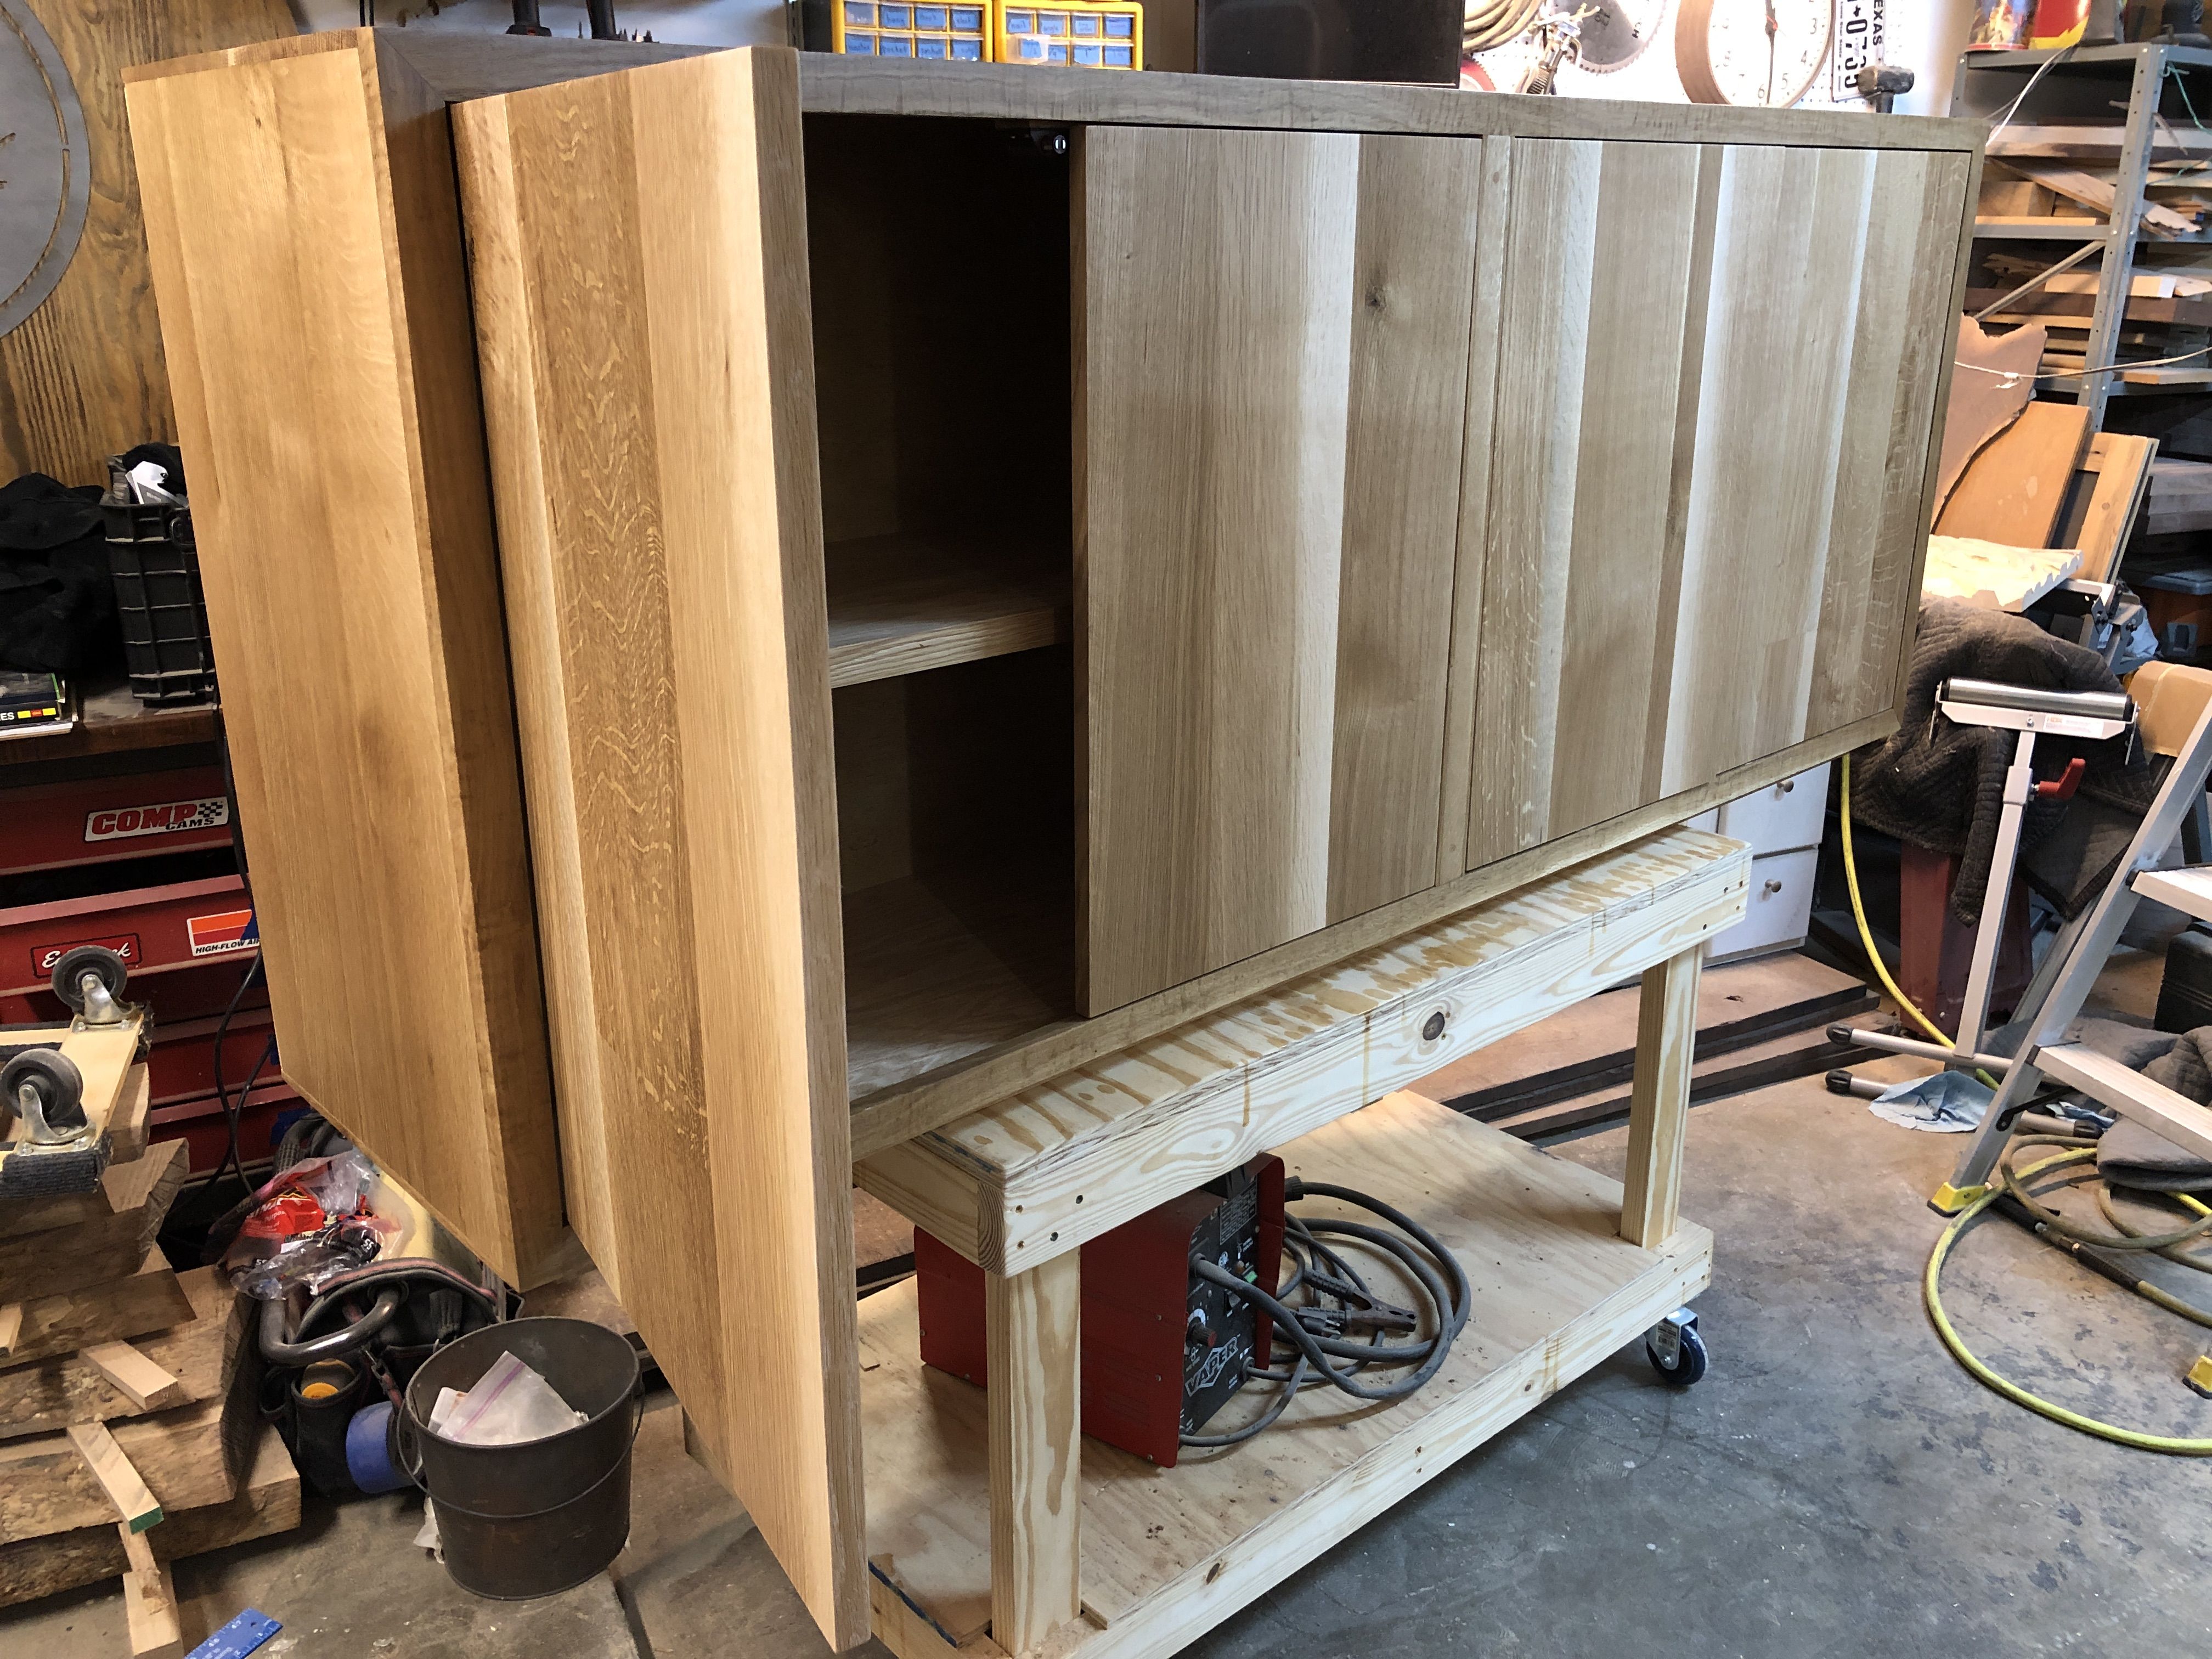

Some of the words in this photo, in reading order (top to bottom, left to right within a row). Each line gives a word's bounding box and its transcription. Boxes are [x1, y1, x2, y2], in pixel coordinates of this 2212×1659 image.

[1757, 83, 1765, 99] 6
[0, 712, 15, 721] ES
[92, 804, 198, 834] COMP
[165, 817, 215, 830] CAMS
[195, 940, 245, 954] HIGH-FLOW
